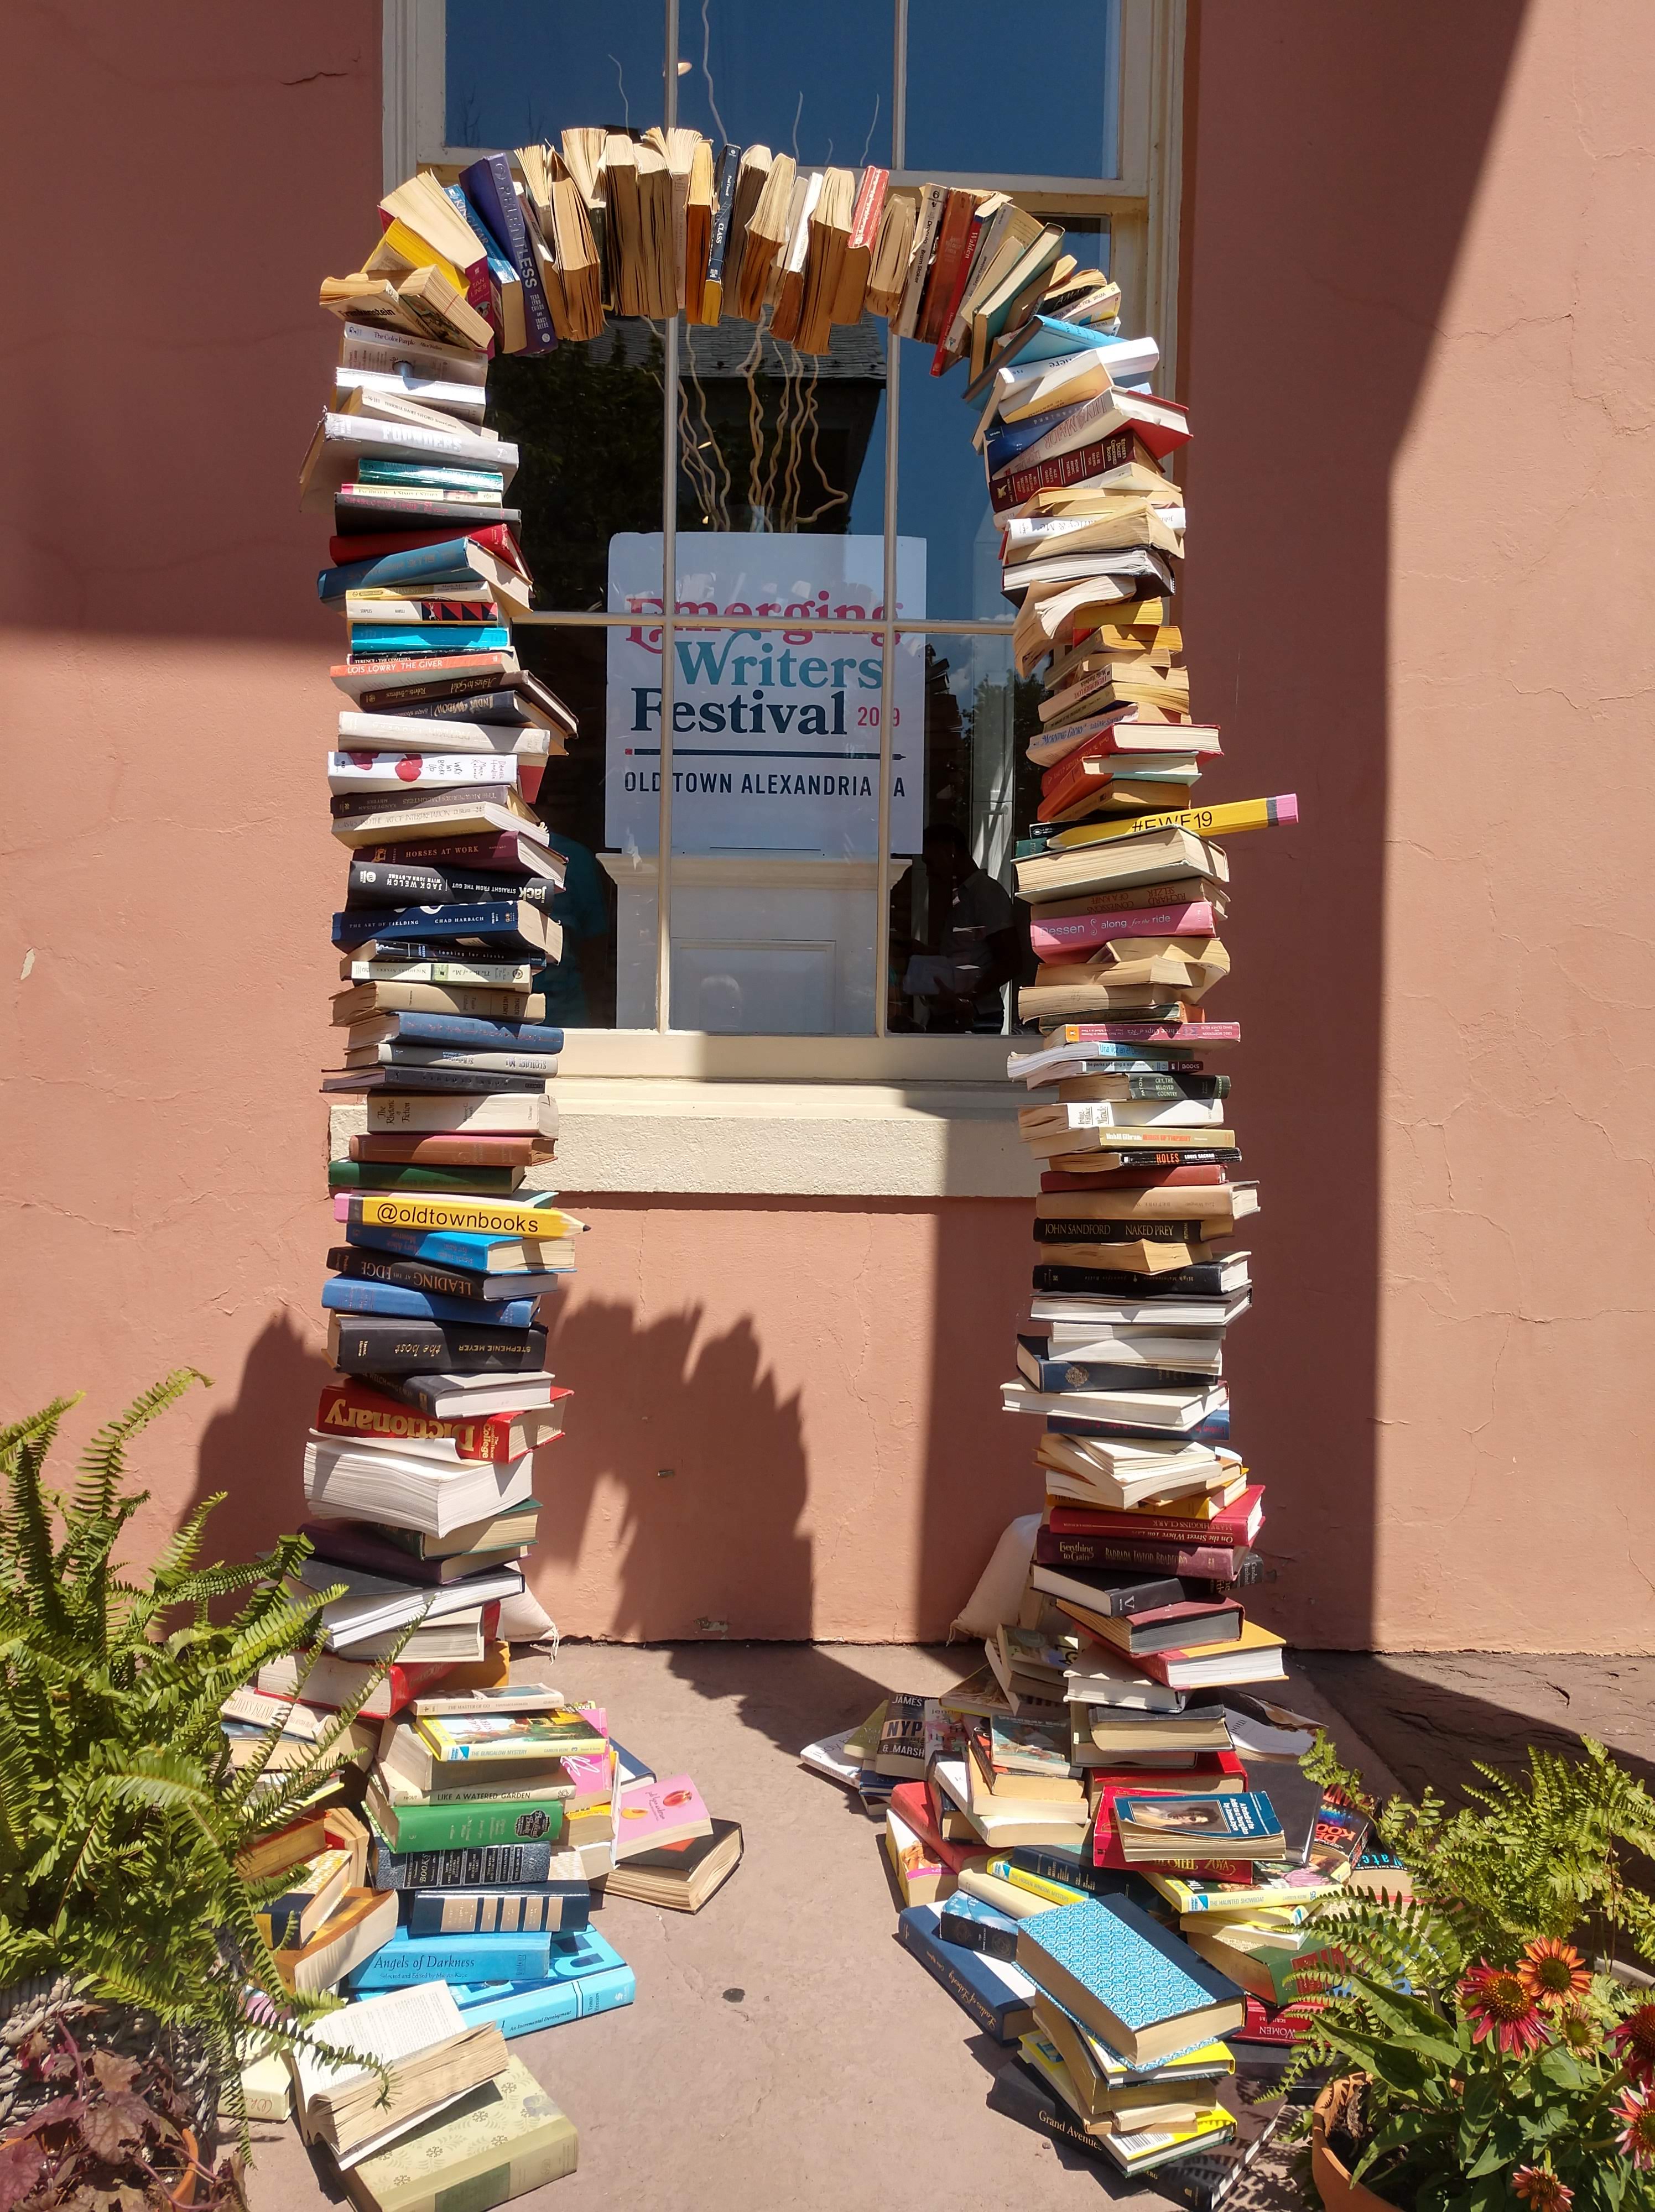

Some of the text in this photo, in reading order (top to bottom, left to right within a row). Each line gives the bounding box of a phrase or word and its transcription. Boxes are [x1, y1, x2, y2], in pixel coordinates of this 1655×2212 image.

[499, 185, 538, 289] RELENTLESS
[716, 222, 725, 244] CLASS
[965, 232, 978, 259] Walden
[472, 276, 485, 288] TAN
[914, 265, 923, 284] Stoker
[471, 283, 487, 298] LINES
[338, 307, 396, 318] Frankenstein
[384, 335, 398, 343] Color
[399, 337, 415, 346] Purple
[417, 412, 434, 421] SWORD
[381, 424, 462, 453] FOUNDERS
[626, 591, 903, 654] Emerging
[347, 660, 443, 675] LOIS LOWRY THE GIVER
[674, 630, 883, 689] Writers
[450, 679, 467, 693] Gold
[631, 687, 847, 735] Festival
[857, 706, 901, 727] 209
[624, 771, 661, 792] OLD
[673, 773, 732, 794] TOWN
[741, 774, 872, 796] ALEXANDRIA
[1132, 811, 1213, 832] #EWF19
[405, 848, 438, 858] HORSES
[455, 846, 479, 854] WORK
[387, 878, 443, 891] JACK WELCH
[491, 886, 517, 894] STRAIGHT
[1146, 886, 1175, 896] SELZER
[518, 885, 548, 903] jack
[1091, 895, 1110, 905] KNIFE
[1119, 892, 1128, 900] OF
[1147, 892, 1186, 905] RICHARD
[1086, 900, 1134, 914] CONFESSIONS
[1039, 924, 1085, 936] Dessen
[1101, 919, 1127, 930] along
[1152, 914, 1171, 923] ride
[1145, 1027, 1160, 1036] Cups
[377, 1105, 386, 1119] The
[385, 1099, 395, 1125] Rhetoric
[402, 1102, 410, 1123] Fiction
[1156, 1153, 1180, 1164] HOLES
[377, 1203, 538, 1233] @oldtownbooks
[1045, 1223, 1174, 1237] JOHN SANDFORD NAKED PREY
[361, 1261, 392, 1280] EDGE
[413, 1272, 471, 1296] LEADING
[394, 1343, 441, 1357] the host
[487, 1344, 532, 1353] STEPHENIE
[324, 1399, 475, 1452] Dictionary
[481, 1423, 490, 1458] College
[1186, 1533, 1207, 1542] Street
[1059, 1541, 1094, 1557] Everything
[1071, 1551, 1090, 1562] Gain
[1105, 1547, 1188, 1566] BARBARA TAYLOR BRADFORD
[892, 1695, 922, 1707] JAMES
[887, 1720, 925, 1738] NYP
[1225, 1808, 1239, 1831] James Joyce
[1242, 1807, 1252, 1819] Portrait
[419, 1854, 431, 1883] BOOKS
[1204, 1859, 1235, 1875] ZOYA
[1019, 1877, 1033, 1886] HIDDEN
[1033, 1882, 1050, 1894] WINDOW
[1051, 1890, 1069, 1901] MYSTERY
[1309, 1890, 1317, 1901] 35
[374, 1954, 475, 1971] Angels of Darkness
[949, 1970, 996, 2031] Ladies of Liberty
[517, 2017, 544, 2030] Incremental
[544, 2010, 571, 2022] Development
[1259, 2026, 1296, 2039] WOMEN
[1038, 2110, 1066, 2132] Grand
